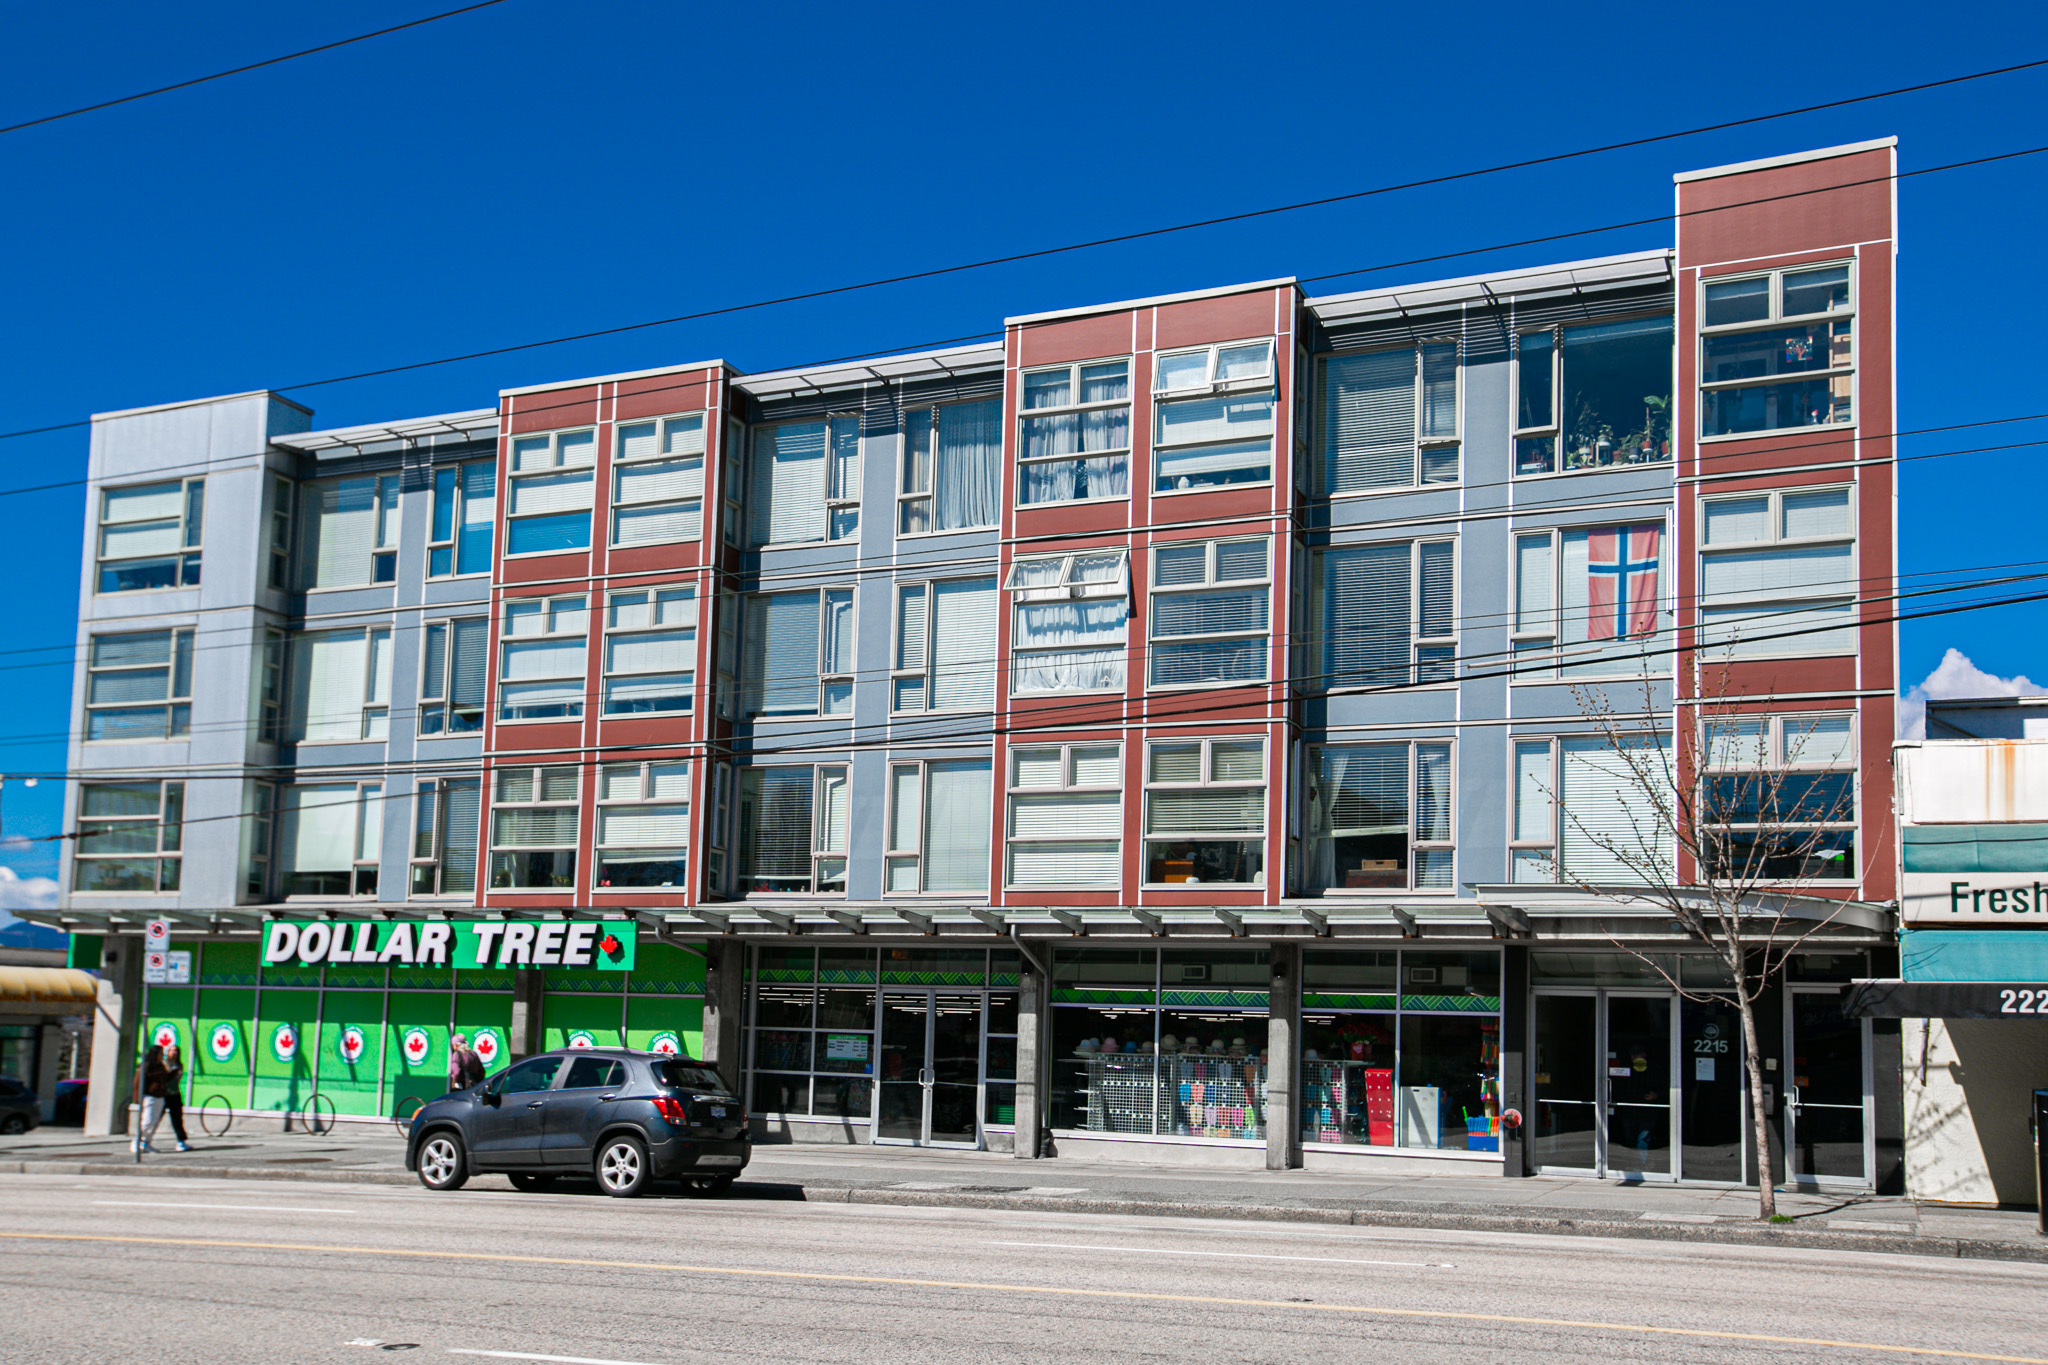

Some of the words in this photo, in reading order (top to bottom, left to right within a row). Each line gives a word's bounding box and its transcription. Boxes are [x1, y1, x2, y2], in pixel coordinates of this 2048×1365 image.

[1950, 881, 2048, 914] Fresh
[265, 923, 451, 963] DOLLAR
[472, 922, 598, 965] TREE
[2000, 989, 2048, 1014] 222
[1693, 1039, 1729, 1054] 2215
